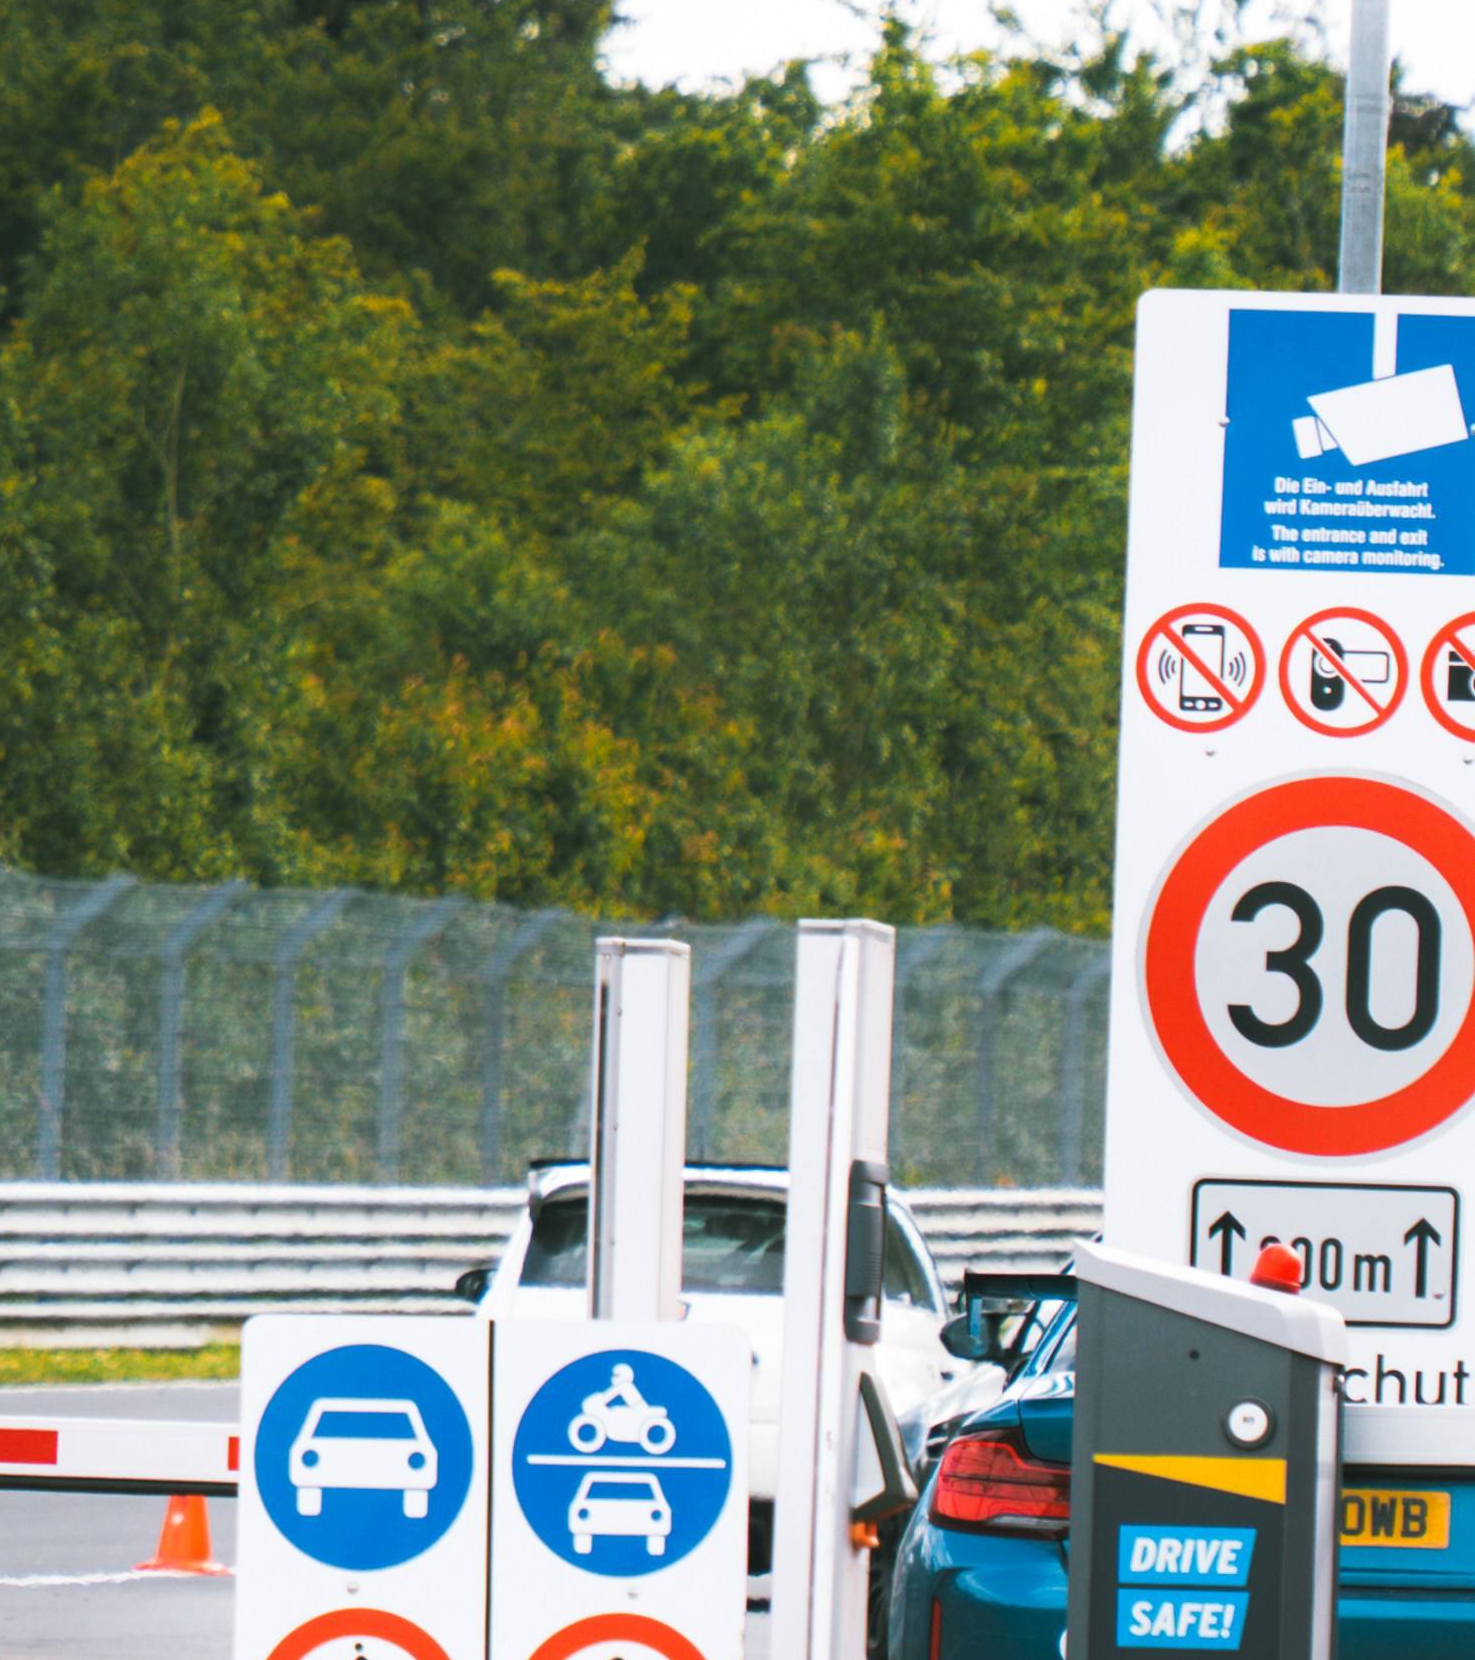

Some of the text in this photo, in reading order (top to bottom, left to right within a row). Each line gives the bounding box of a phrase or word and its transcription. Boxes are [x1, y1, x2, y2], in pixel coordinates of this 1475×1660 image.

[1274, 477, 1428, 497] Die Ein- und Ausfahrt
[1264, 499, 1436, 518] wird Kameraüberwacht.
[1272, 525, 1428, 545] The entrance and exit
[1252, 545, 1444, 570] is with camera monitoring.
[1227, 881, 1442, 1051] 30
[1130, 1536, 1243, 1574] DRIVE
[1129, 1601, 1235, 1639] SAFE!
